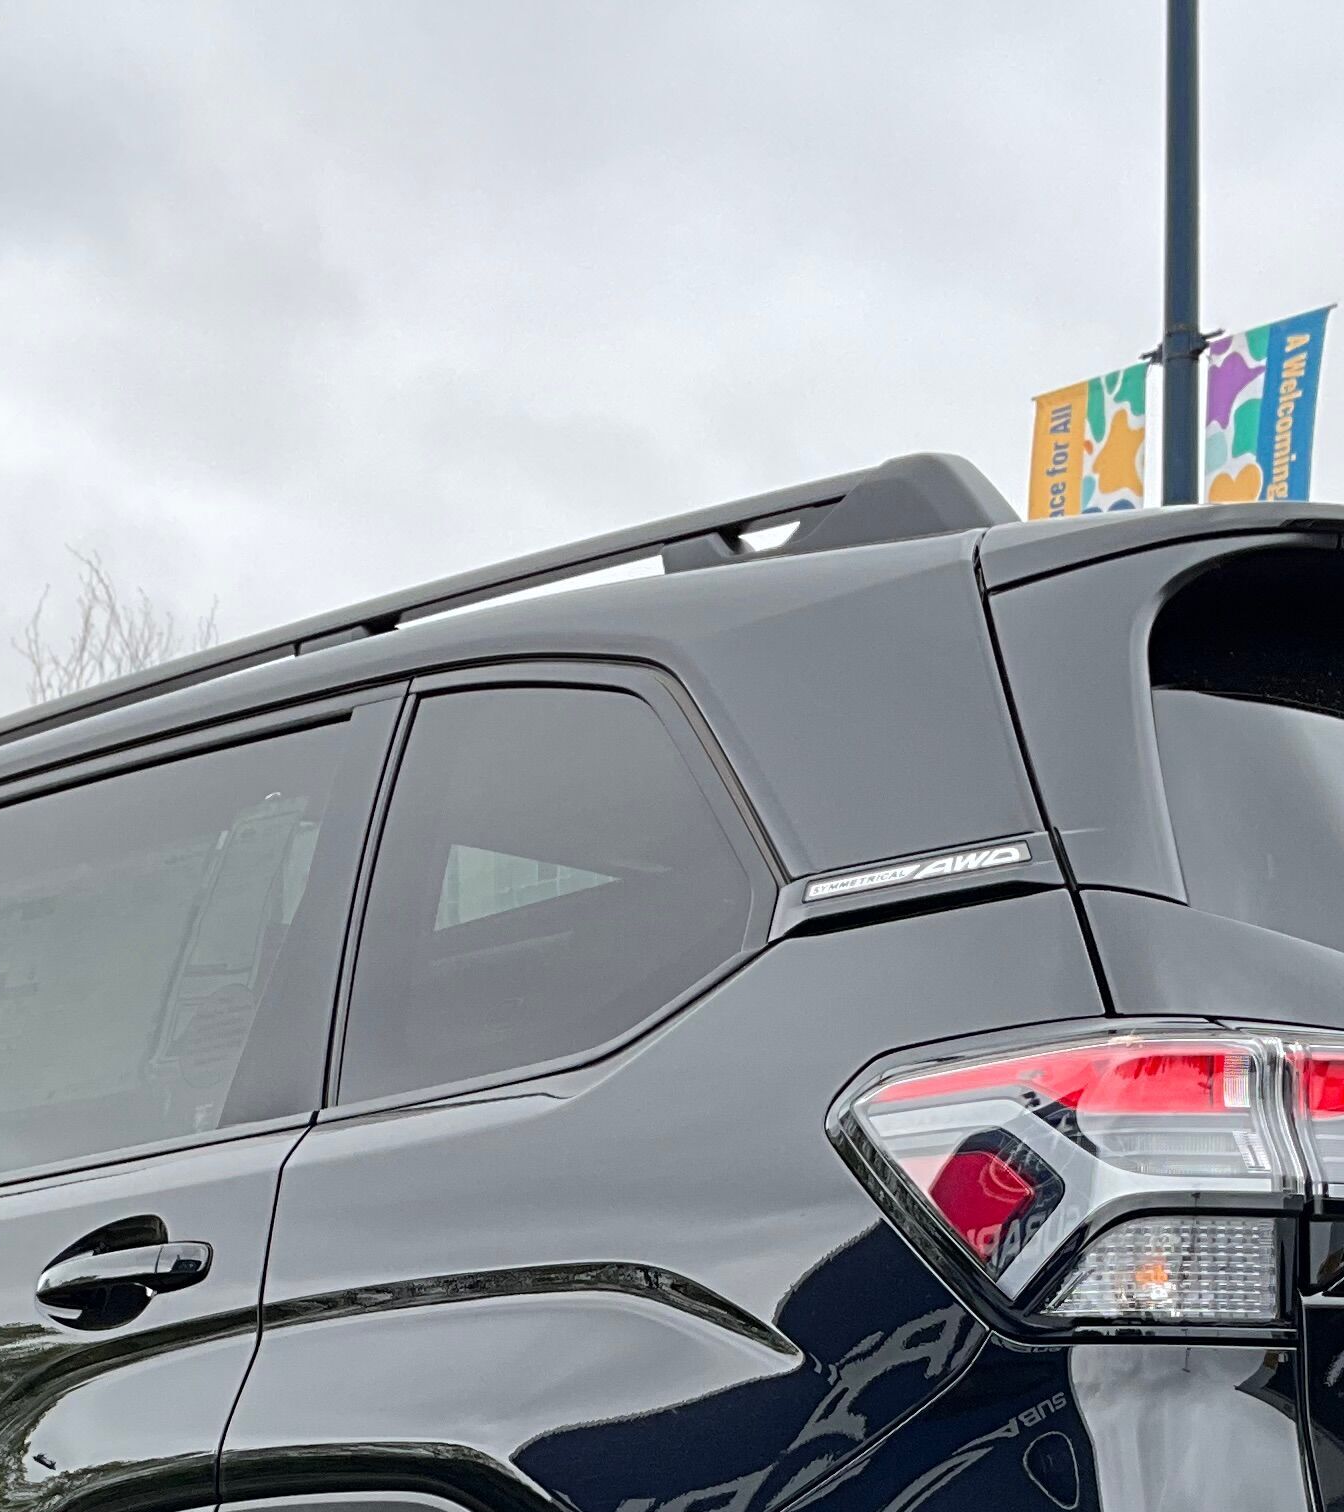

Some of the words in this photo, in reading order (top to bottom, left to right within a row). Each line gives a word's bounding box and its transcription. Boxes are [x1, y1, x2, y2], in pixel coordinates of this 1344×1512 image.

[1285, 333, 1310, 352] A
[1049, 404, 1072, 434] All
[1267, 351, 1307, 502] Welcoming
[1046, 441, 1069, 476] for
[810, 869, 907, 895] SYMMETRICAL
[913, 847, 1020, 879] AWD
